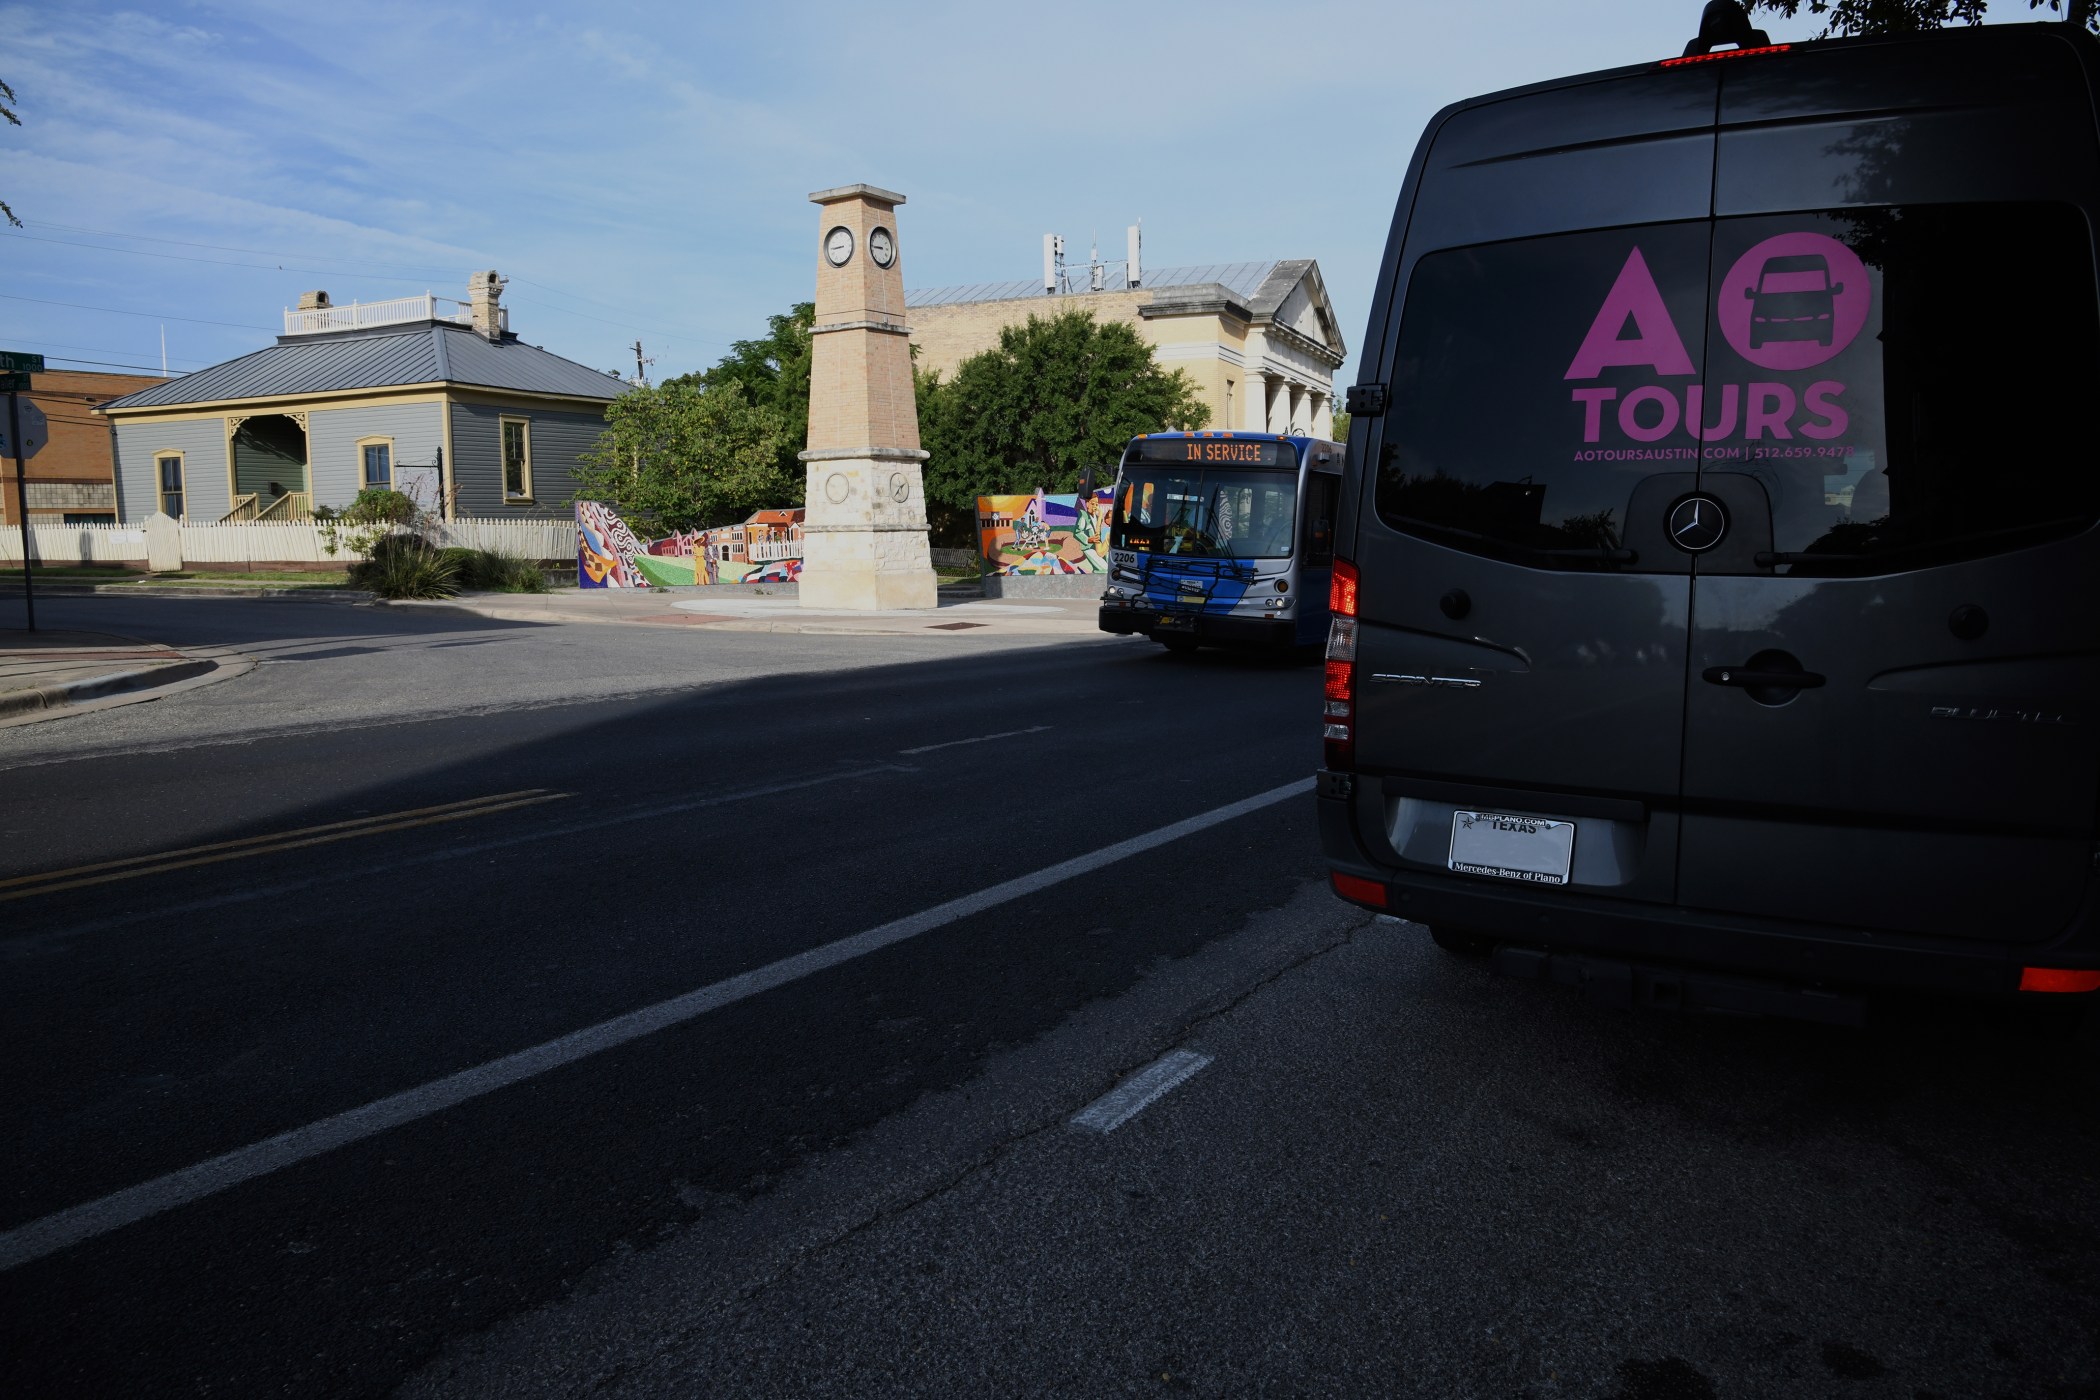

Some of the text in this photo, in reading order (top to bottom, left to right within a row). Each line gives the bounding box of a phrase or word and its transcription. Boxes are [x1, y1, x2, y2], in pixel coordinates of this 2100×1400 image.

[22, 363, 43, 372] 1000
[1572, 379, 1849, 443] TOURS
[1187, 443, 1261, 461] IN SERVICE
[1573, 446, 1855, 462] AOTOURSAUSTINCOM 512.659.9478
[1114, 552, 1135, 563] 2206
[1491, 820, 1537, 834] TEXAS
[1455, 862, 1561, 884] Mercedes-Benz of Plano
